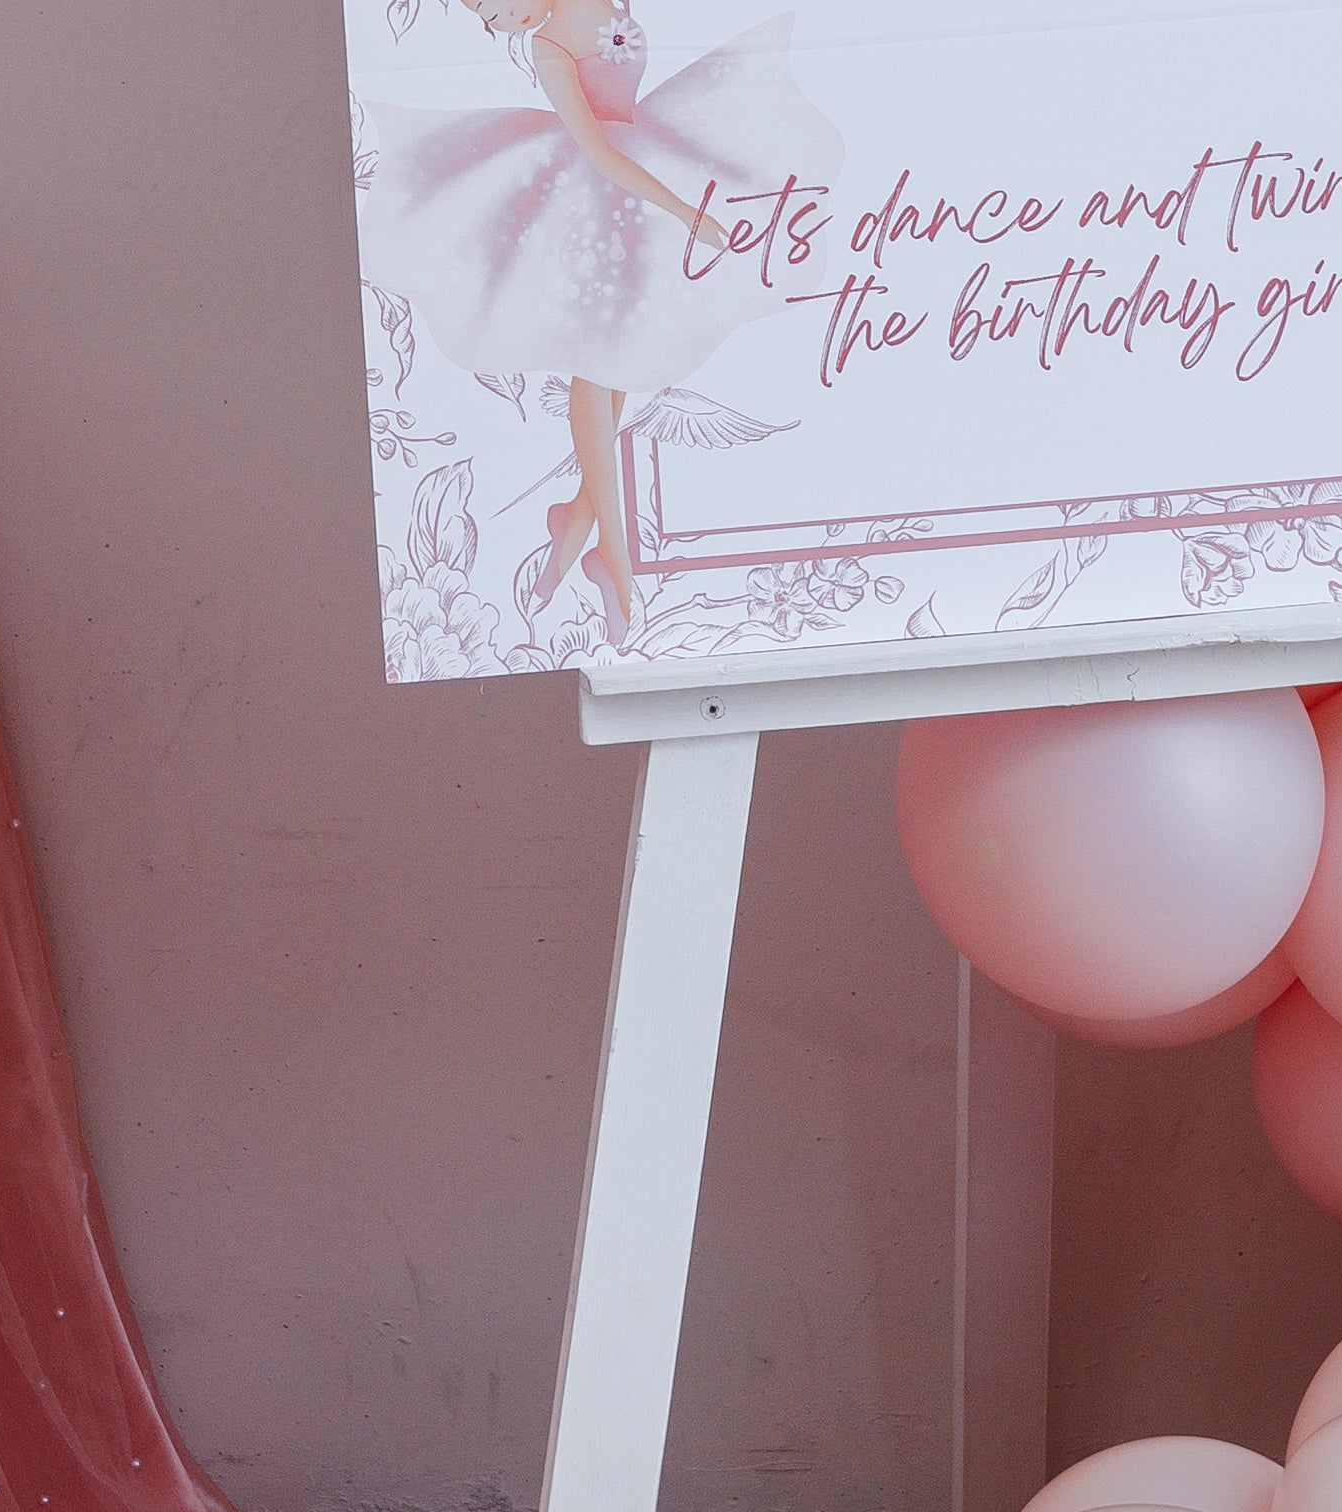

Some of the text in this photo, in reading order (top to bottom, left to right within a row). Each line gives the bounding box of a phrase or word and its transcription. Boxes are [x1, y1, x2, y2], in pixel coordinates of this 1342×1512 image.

[682, 173, 830, 288] Lets
[850, 170, 1063, 269] dance
[1079, 145, 1224, 234] and
[785, 273, 930, 388] the
[949, 253, 1233, 371] birthday
